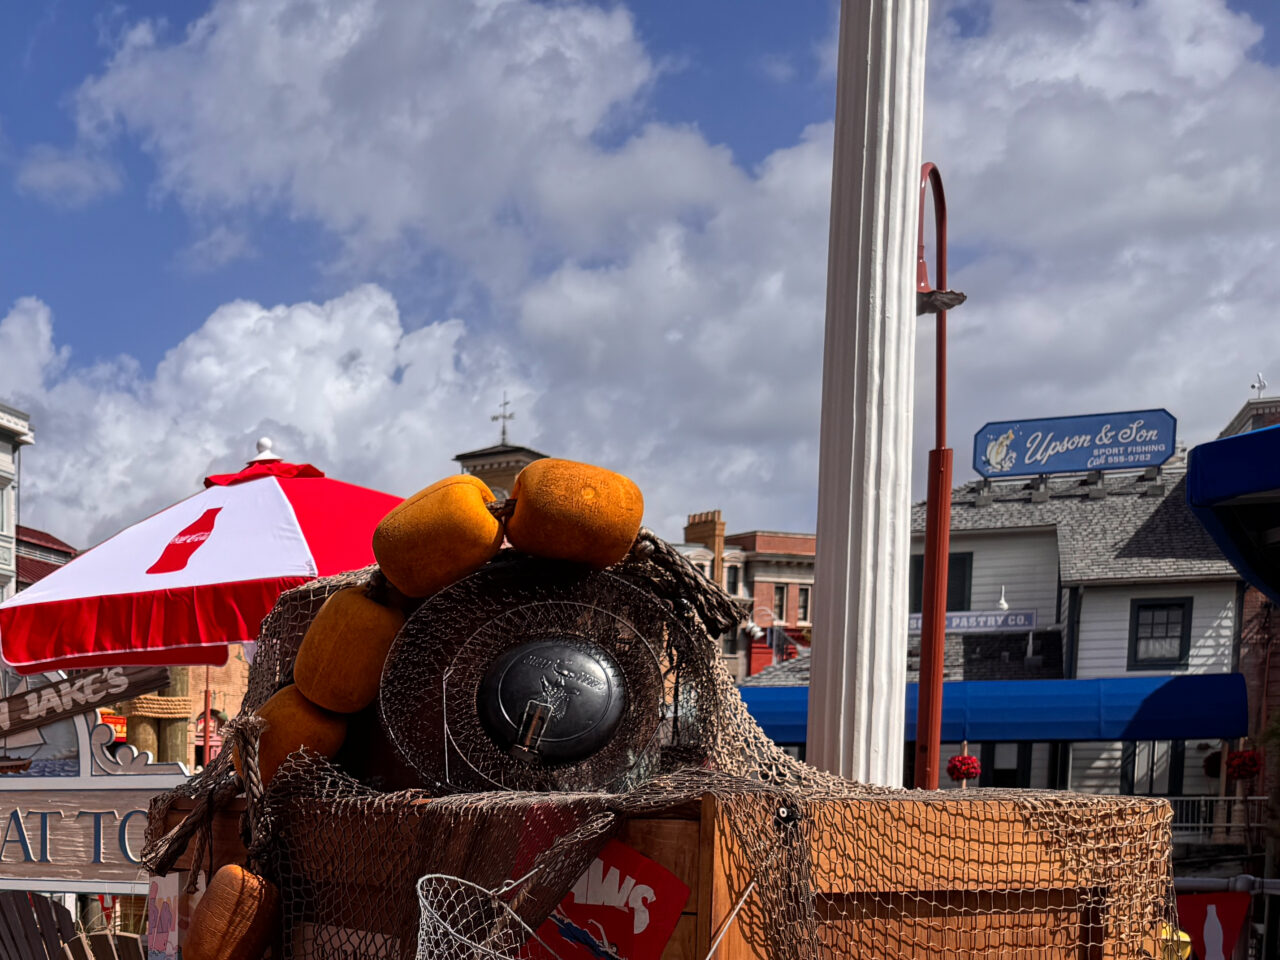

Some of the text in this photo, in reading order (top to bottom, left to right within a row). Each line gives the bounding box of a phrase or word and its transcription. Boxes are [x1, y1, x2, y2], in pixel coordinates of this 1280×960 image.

[1024, 419, 1158, 465] Upson & Son
[1093, 443, 1166, 456] SPORT FISHING
[1087, 456, 1107, 468] Call
[951, 615, 1029, 627] PASTRY CO.
[21, 666, 129, 721] JAKE'S
